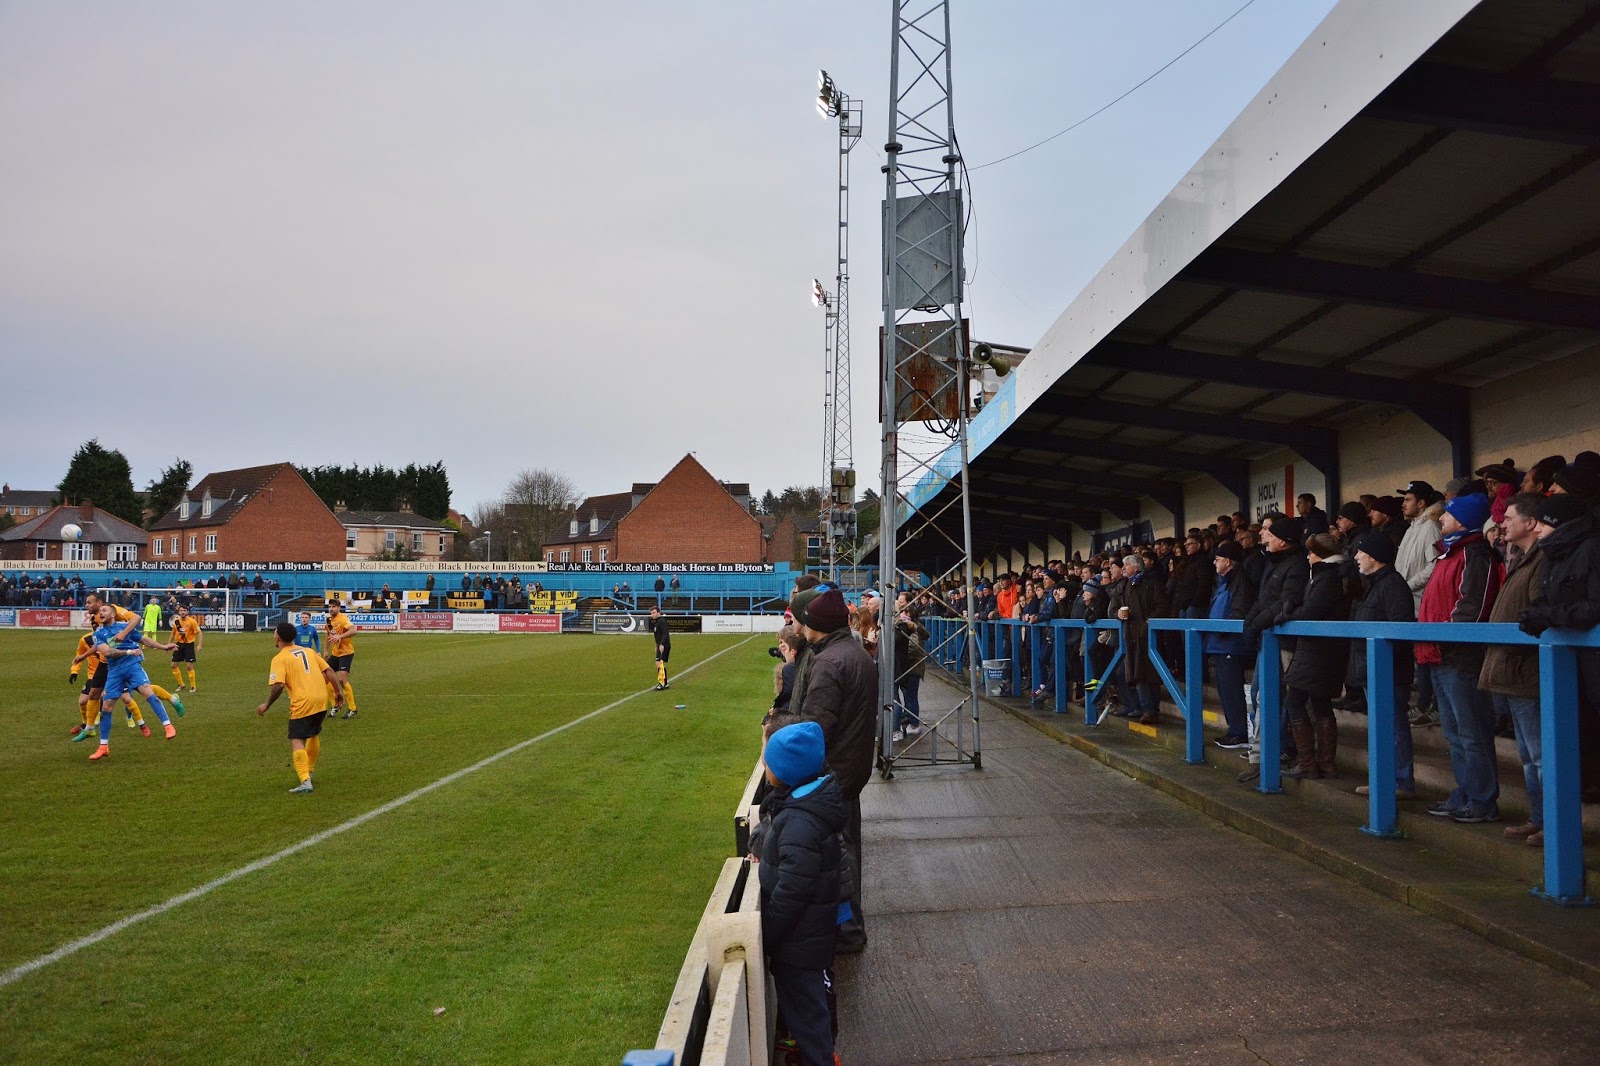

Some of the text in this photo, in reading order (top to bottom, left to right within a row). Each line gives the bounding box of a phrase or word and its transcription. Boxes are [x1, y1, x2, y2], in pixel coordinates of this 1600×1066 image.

[1258, 482, 1277, 502] HOLY
[269, 562, 283, 570] Inn
[285, 562, 311, 571] Blyton
[508, 563, 535, 571] Blyton
[734, 564, 762, 572] Blyton
[292, 650, 310, 674] 7
